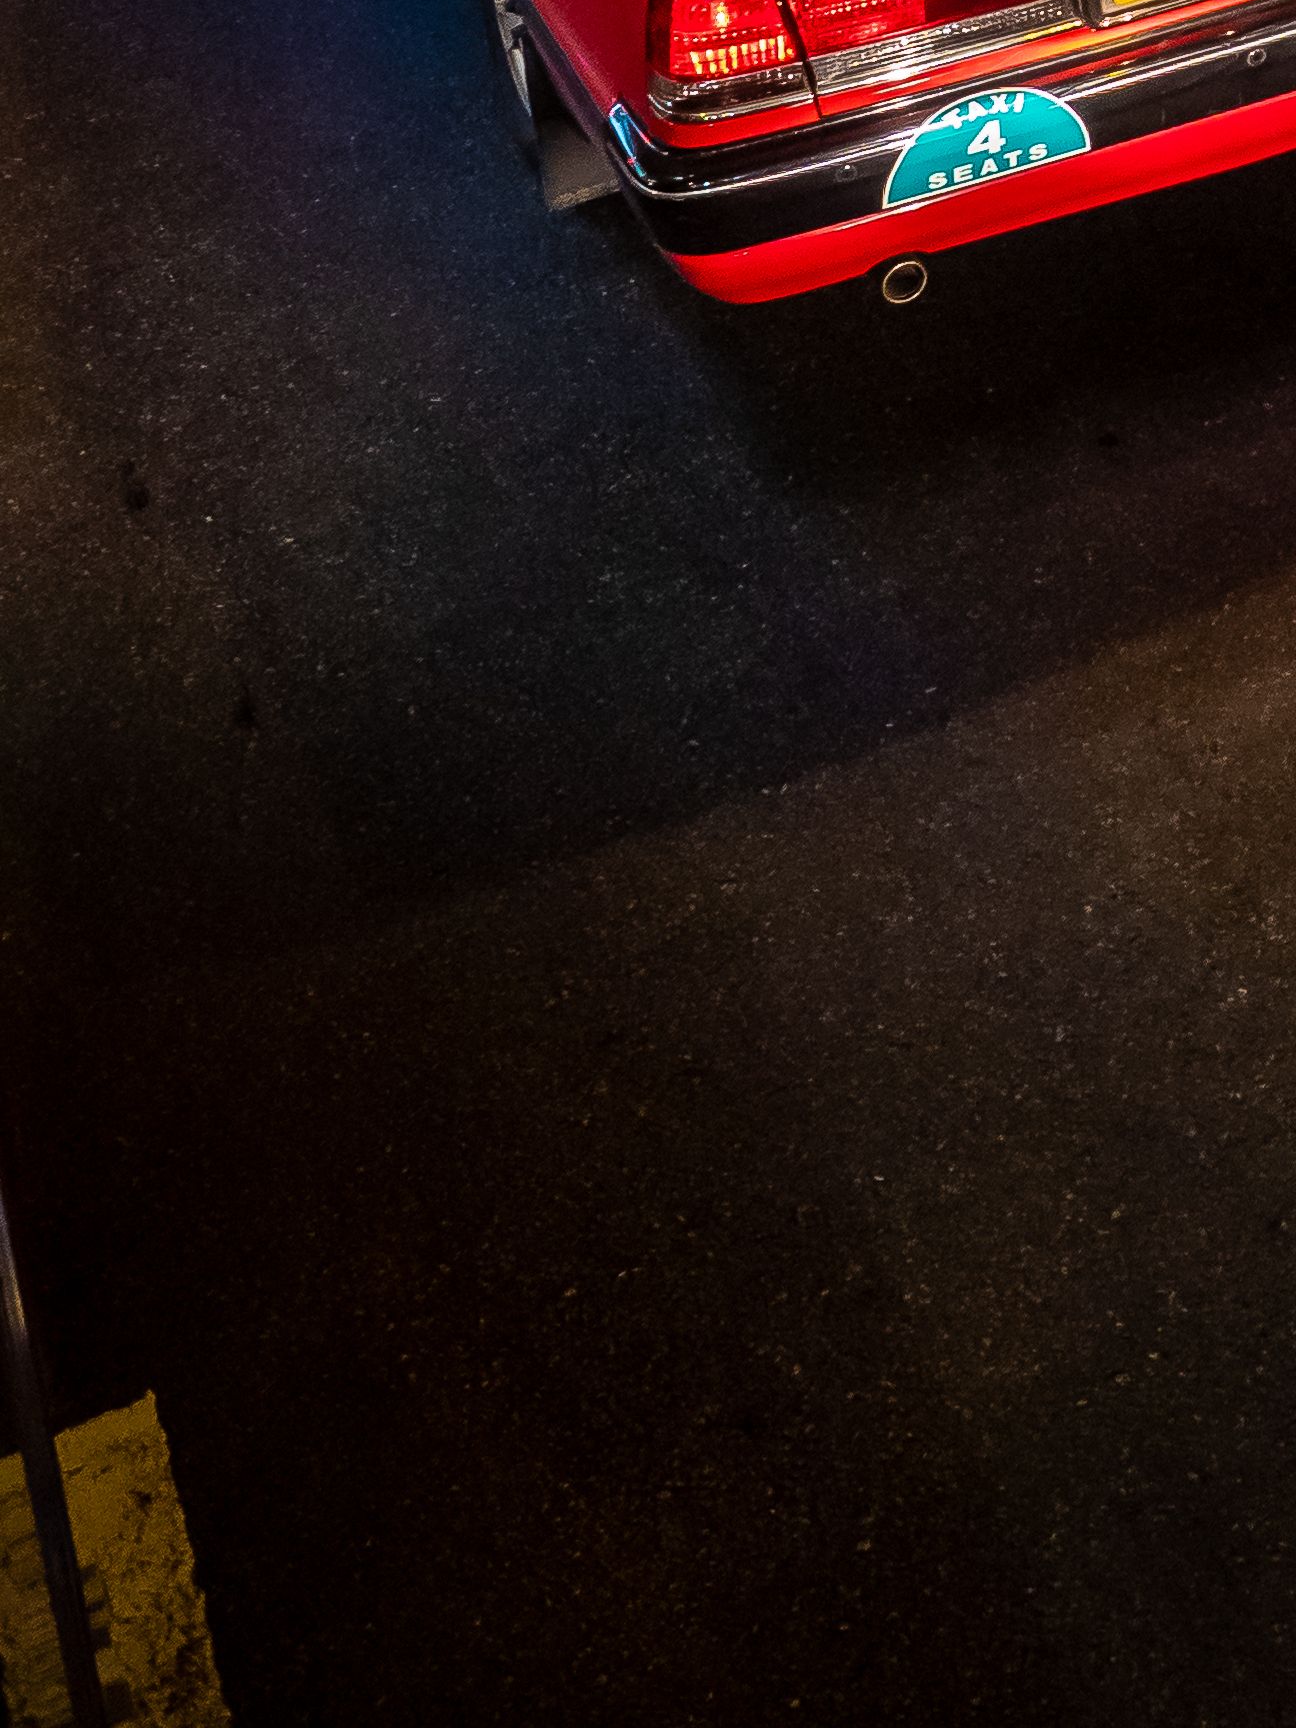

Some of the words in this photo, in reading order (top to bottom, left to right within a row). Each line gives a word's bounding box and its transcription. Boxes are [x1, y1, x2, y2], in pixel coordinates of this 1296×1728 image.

[941, 92, 1025, 130] TAXI
[967, 119, 1007, 155] 4
[928, 143, 1048, 190] SEATS
